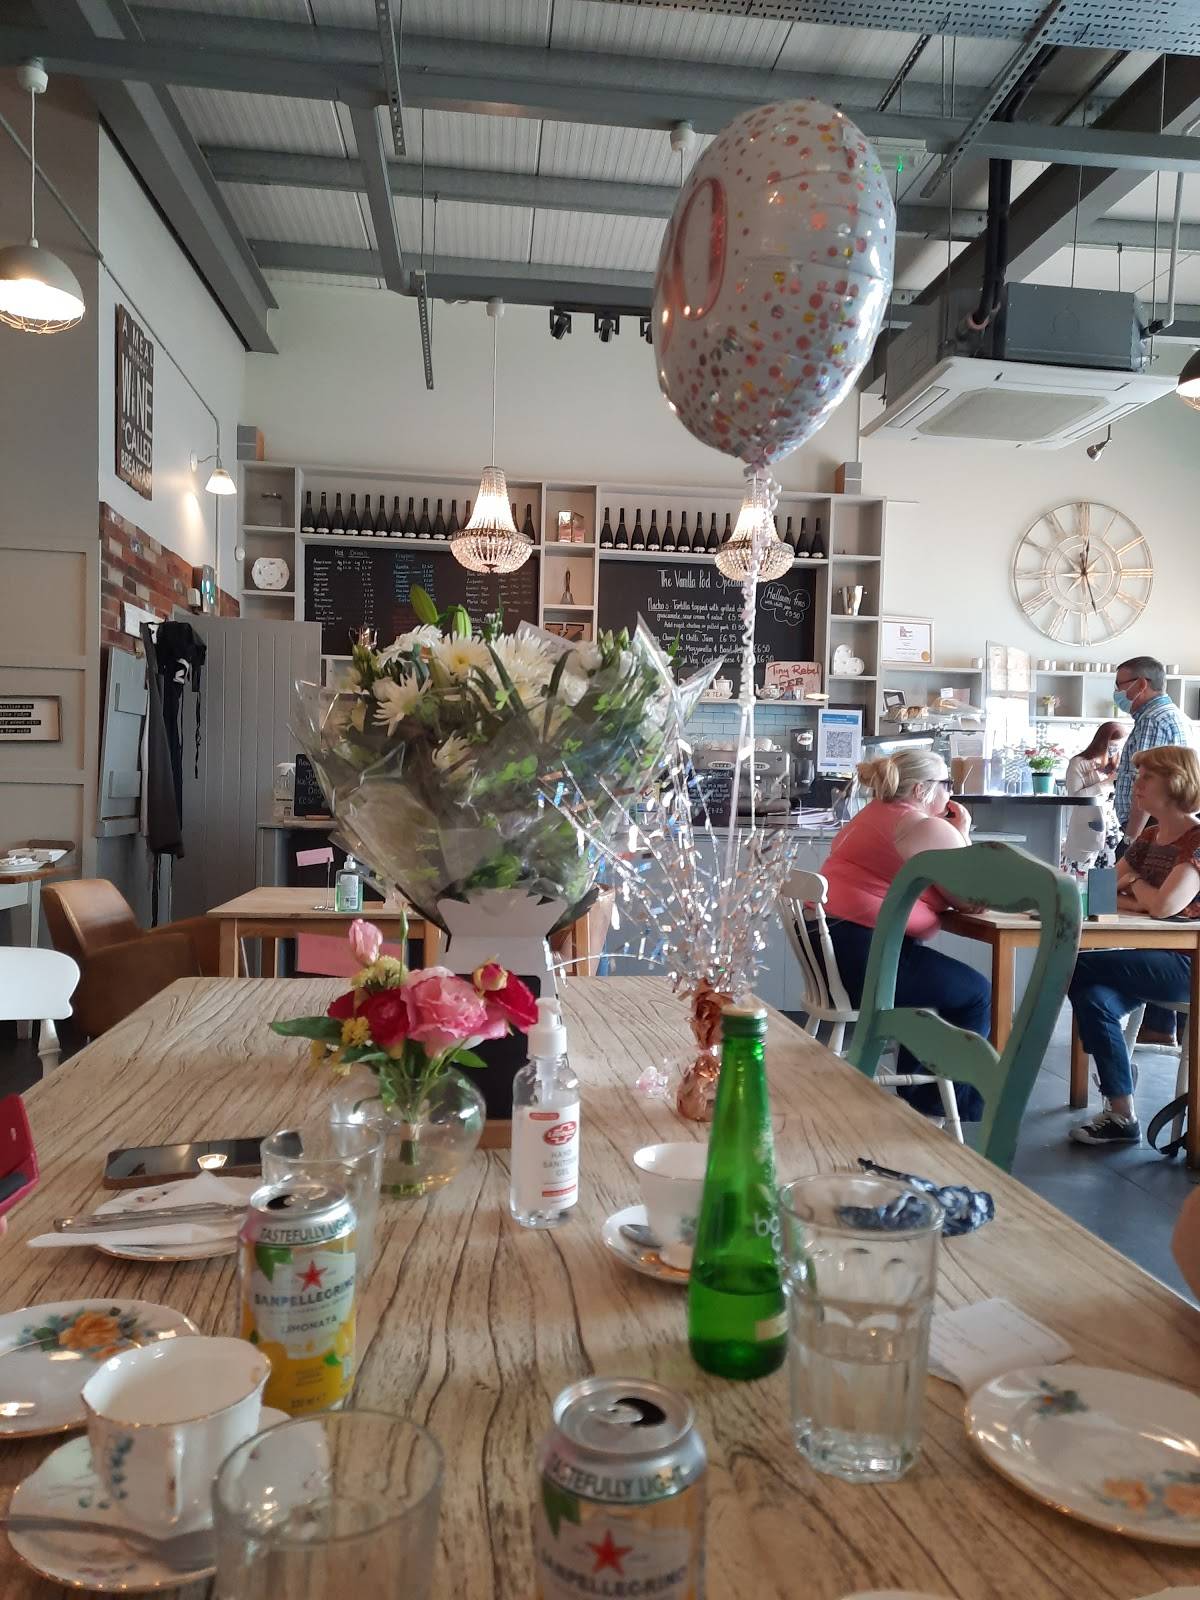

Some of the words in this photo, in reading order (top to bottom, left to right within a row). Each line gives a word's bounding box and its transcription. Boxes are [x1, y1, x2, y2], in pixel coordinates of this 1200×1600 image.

[122, 315, 128, 337] A
[132, 324, 154, 368] MEAL
[125, 422, 152, 468] CALLED
[657, 569, 673, 588] The
[674, 569, 697, 589] Vanilla
[699, 569, 711, 589] Pod
[702, 633, 714, 642] Jam
[768, 663, 789, 678] Tiny
[791, 663, 820, 675] Rebel
[260, 1223, 326, 1242] TASTEFULLY
